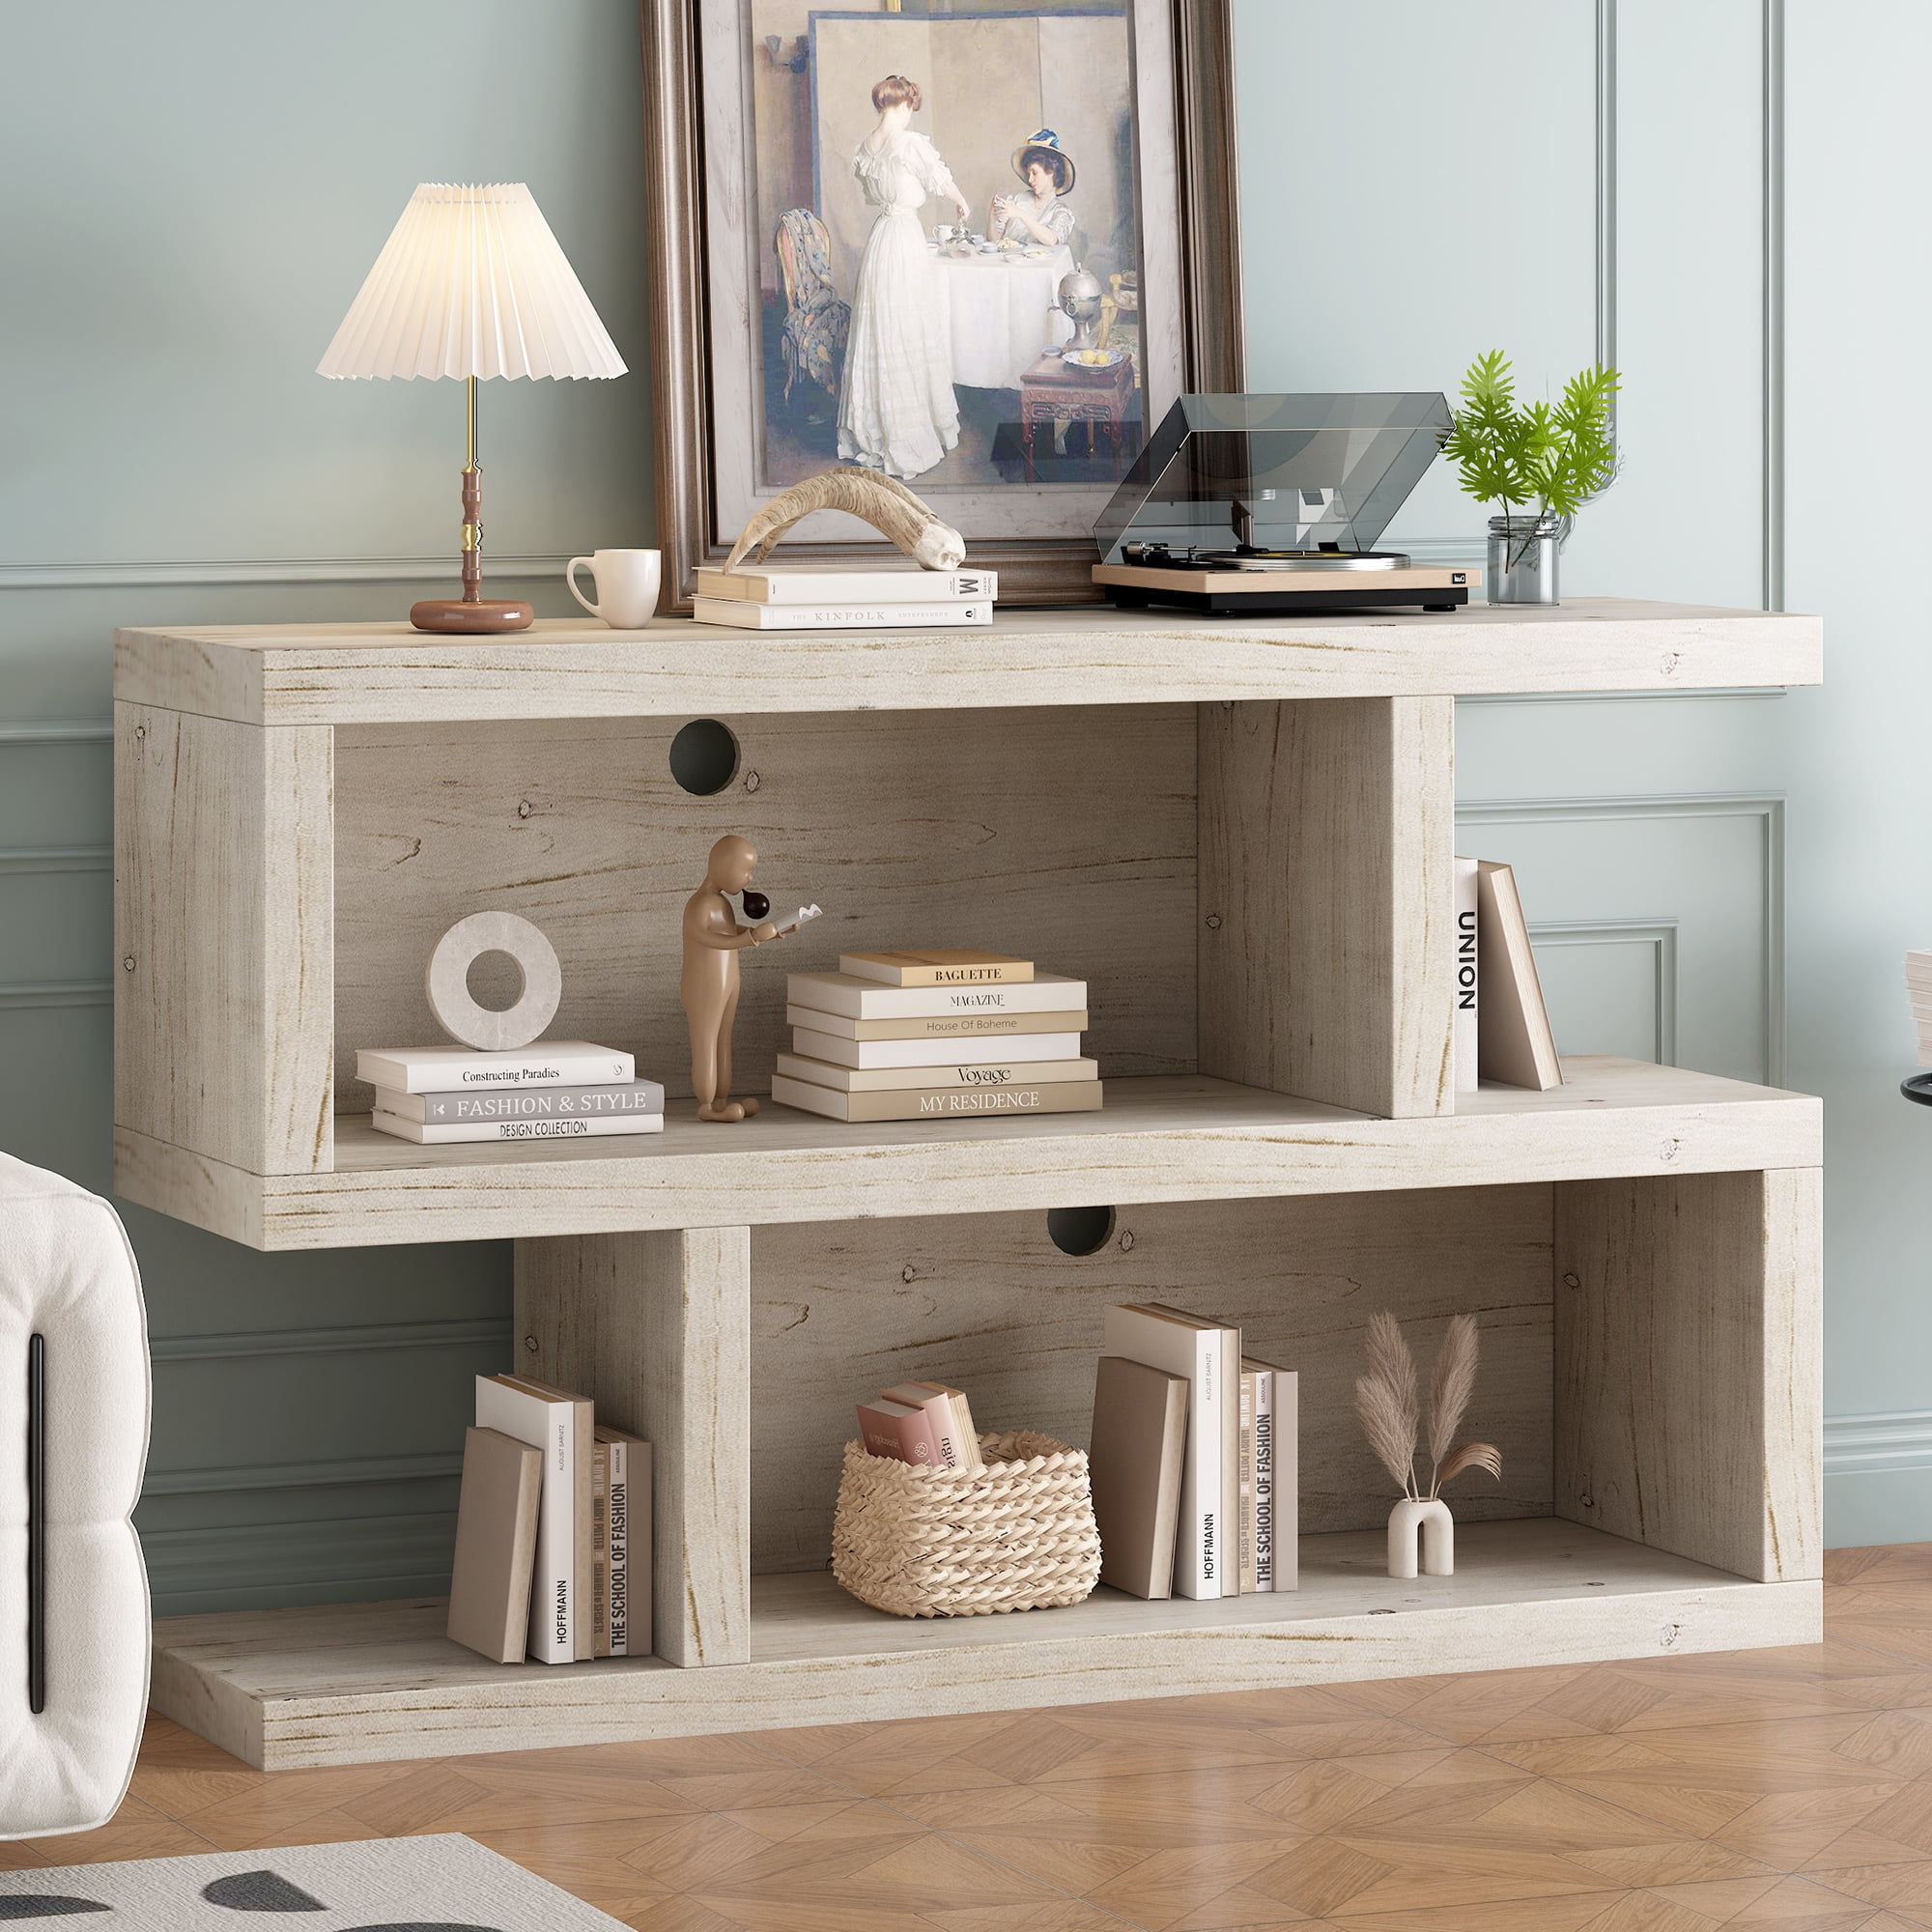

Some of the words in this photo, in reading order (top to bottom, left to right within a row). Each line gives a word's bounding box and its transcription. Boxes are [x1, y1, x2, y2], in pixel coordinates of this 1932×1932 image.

[959, 579, 979, 595] M
[814, 611, 886, 621] KINFOLK
[1458, 911, 1476, 1009] UNION
[935, 968, 1002, 981] BAGUETTE
[950, 994, 1005, 1007] MAGAZINE
[926, 1021, 958, 1031] House
[961, 1020, 974, 1030] Of
[977, 1019, 1017, 1029] Boheme
[463, 1069, 520, 1082] Constructing
[523, 1067, 560, 1079] Paradies
[958, 1067, 1011, 1085] Voyage
[457, 1096, 552, 1117] FASHION
[558, 1095, 574, 1111] &
[581, 1093, 646, 1111] STYLE
[920, 1095, 946, 1112] MY
[950, 1092, 1039, 1110] RESIDENCE
[500, 1123, 532, 1137] DESIGN
[535, 1121, 587, 1136] COLLECTION
[1257, 1414, 1270, 1473] FASHION
[1257, 1477, 1270, 1494] OF
[611, 1483, 625, 1541] FASHION
[1257, 1497, 1270, 1553] SCHOOL
[611, 1544, 625, 1562] OF
[1204, 1514, 1214, 1579] HOFFMANN
[1257, 1556, 1270, 1584] THE
[611, 1564, 625, 1618] SCHOOL
[557, 1580, 567, 1644] HOFFMANN
[611, 1621, 625, 1648] THE
